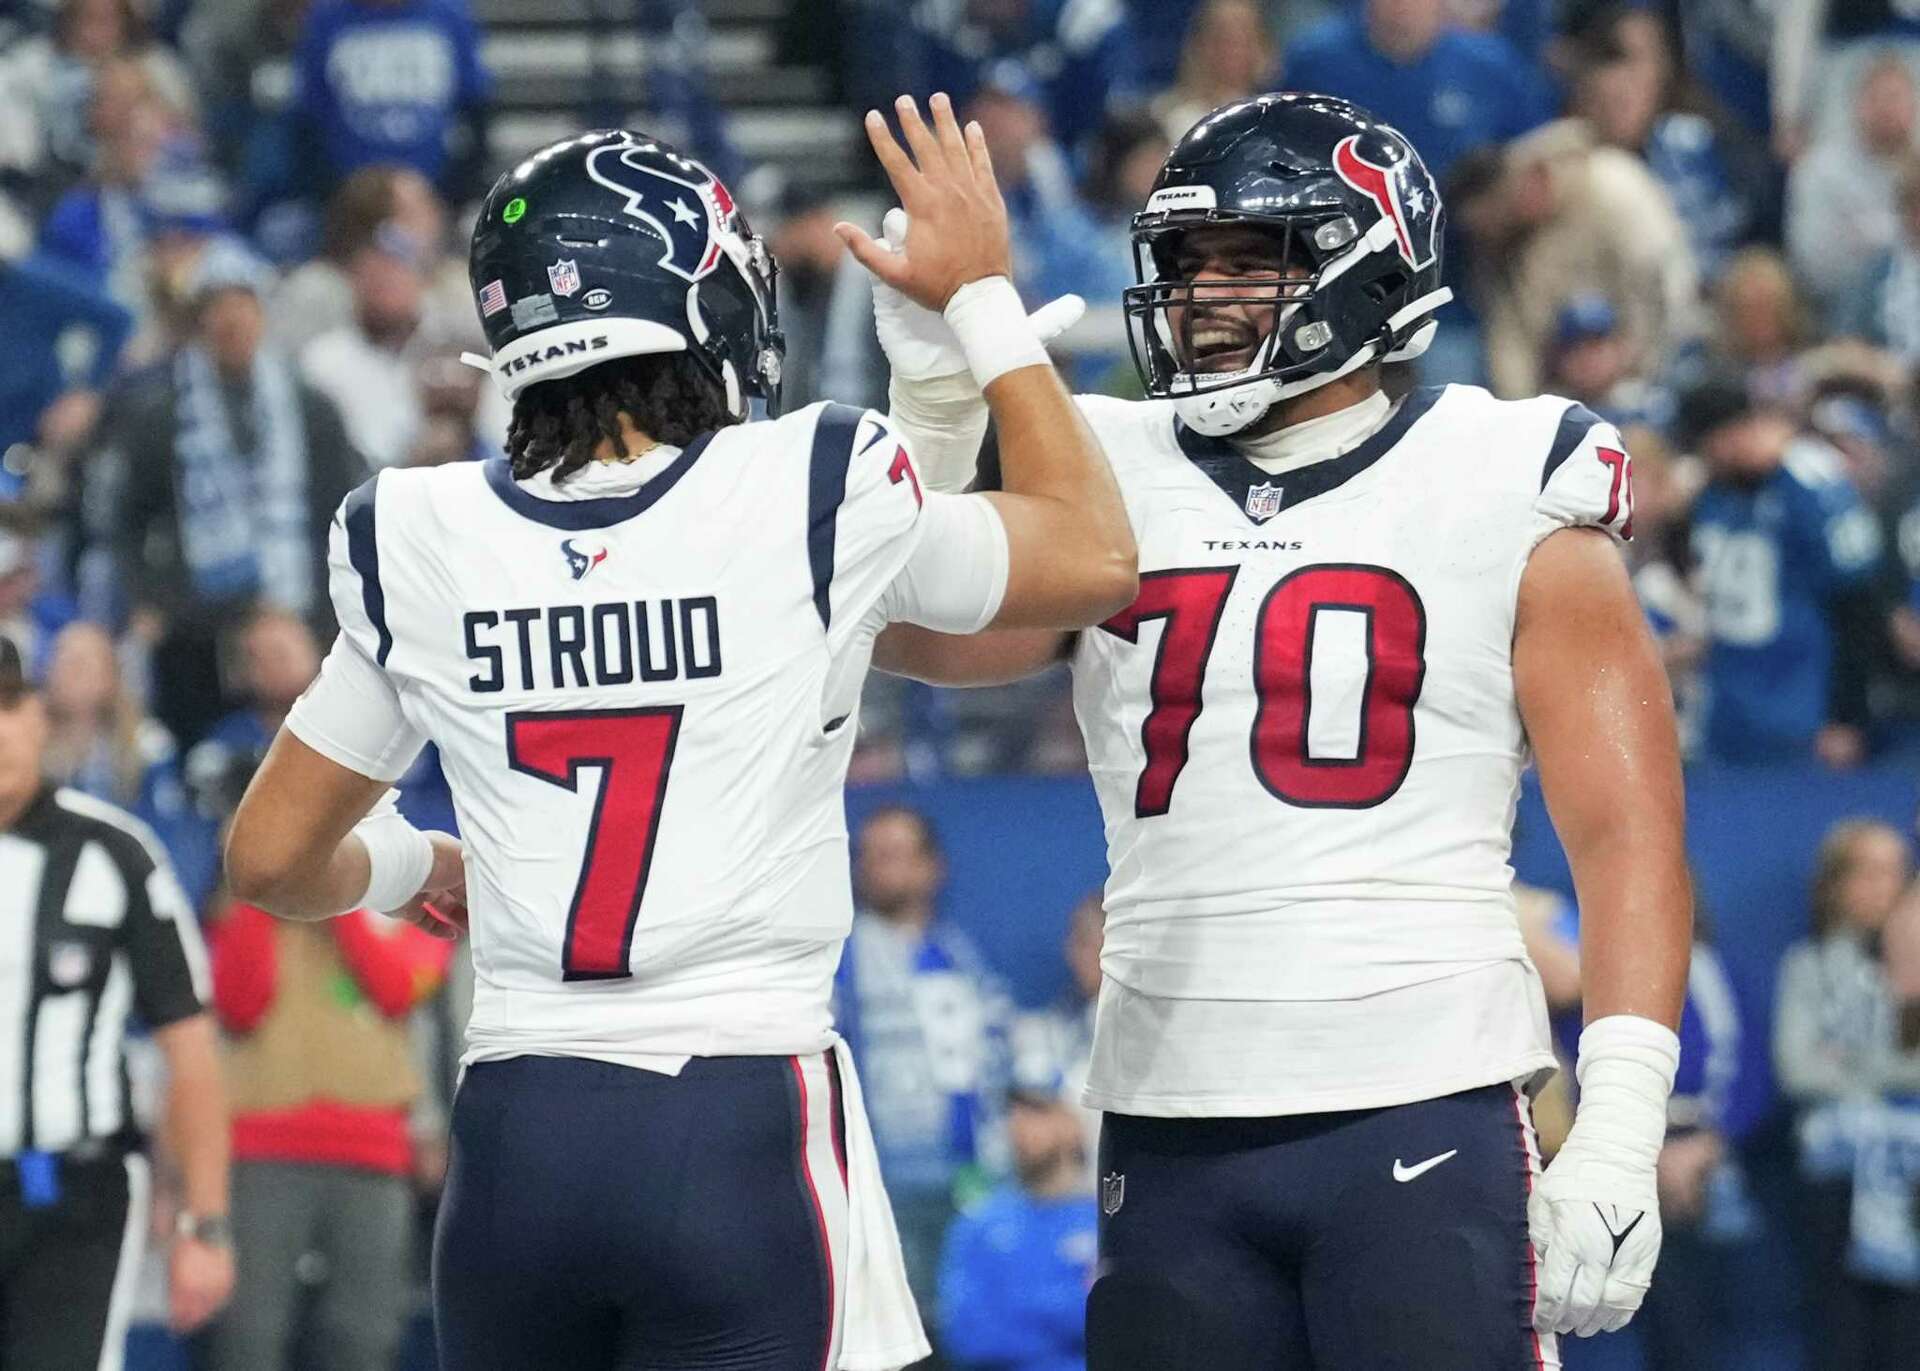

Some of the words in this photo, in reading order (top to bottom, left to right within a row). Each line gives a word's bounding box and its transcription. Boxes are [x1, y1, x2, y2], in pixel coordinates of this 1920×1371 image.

[500, 336, 608, 378] TEXANS
[887, 443, 922, 512] 7
[1251, 498, 1276, 513] NFL
[1202, 540, 1303, 551] TEXANS
[463, 596, 722, 693] STROUD
[1097, 562, 1428, 820] 70
[505, 704, 685, 982] 7
